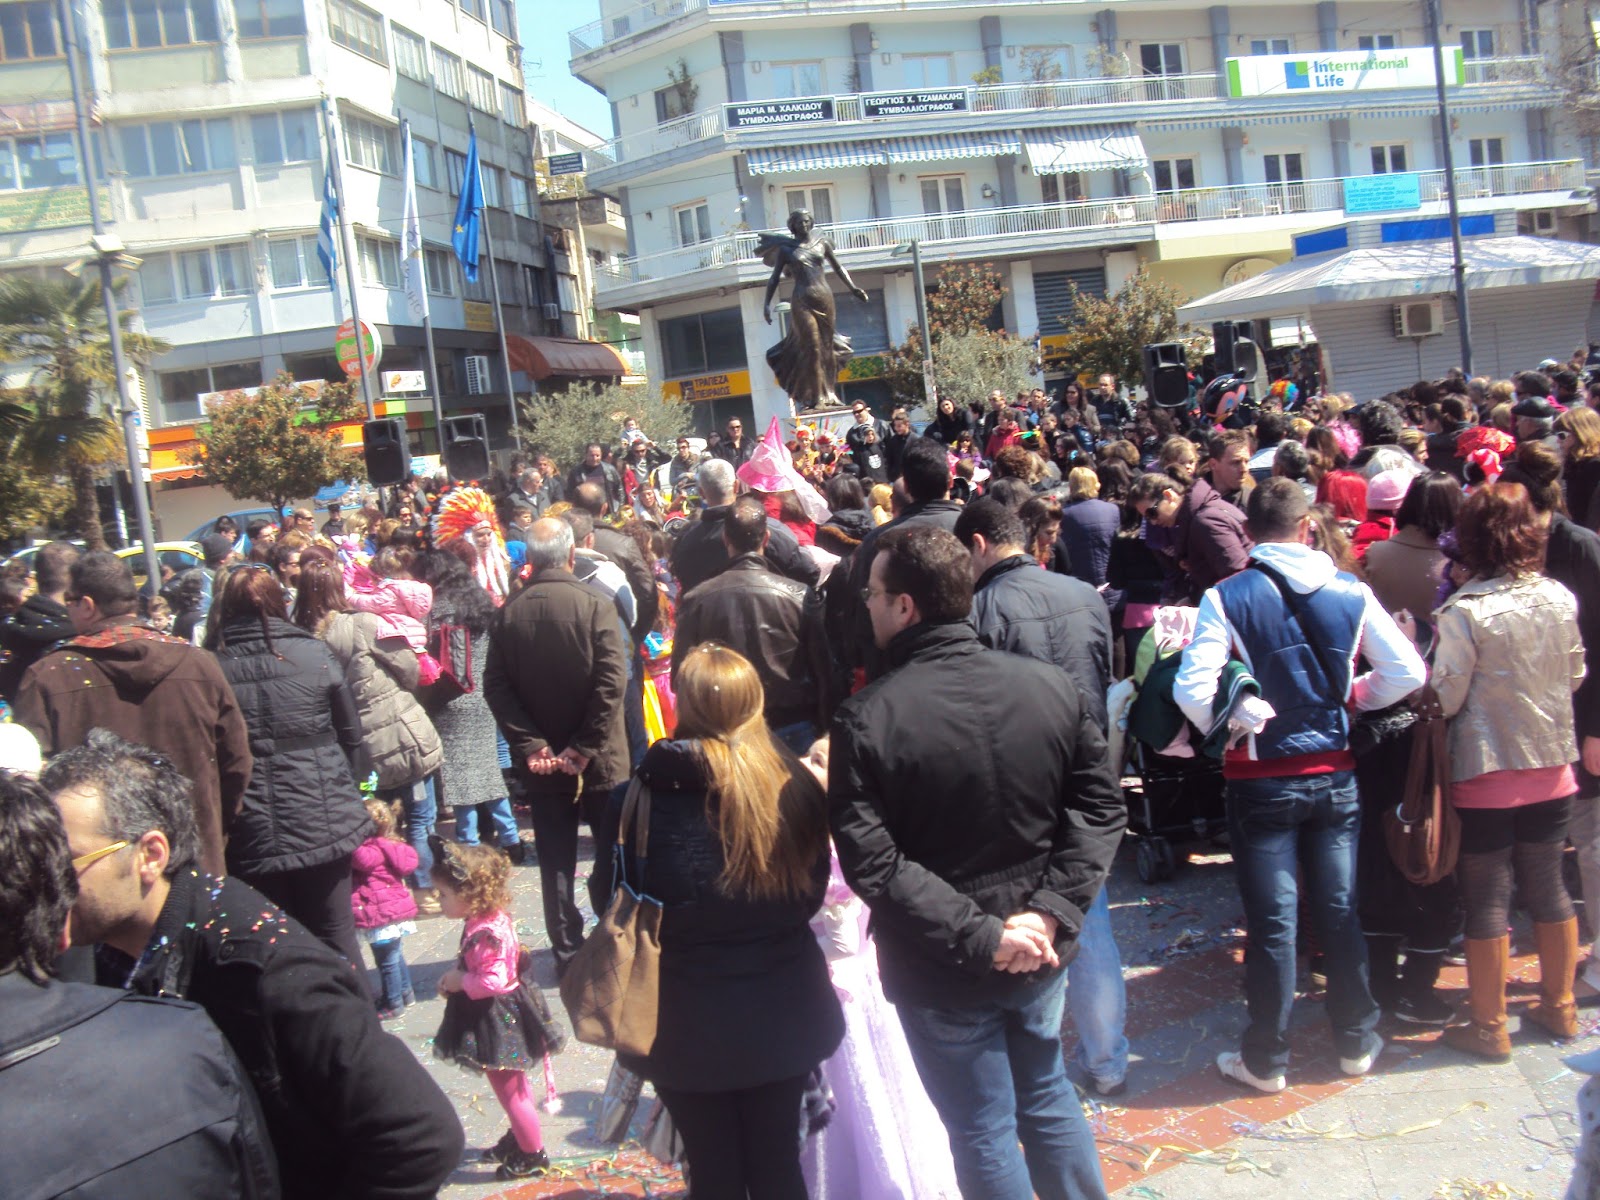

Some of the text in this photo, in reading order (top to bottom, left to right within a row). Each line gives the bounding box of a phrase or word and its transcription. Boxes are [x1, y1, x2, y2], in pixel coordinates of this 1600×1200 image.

[1313, 56, 1409, 73] International
[1315, 74, 1345, 88] Life
[864, 96, 905, 106] ΓΕΩΡΓΙΟΣ
[737, 106, 766, 116] ΜΑΡΙΑ
[779, 102, 823, 113] ΧΑΛΚΙΔΟΥ
[878, 102, 955, 115] ΣΥΜΒΟΛΑΙΟΓΡΑΦΟΣ
[738, 111, 825, 126] ΣΥΜΒΟΛΑΙΟΓΡΑΦΟΣ
[694, 375, 729, 388] ΤΡΑΠΕΖΑ
